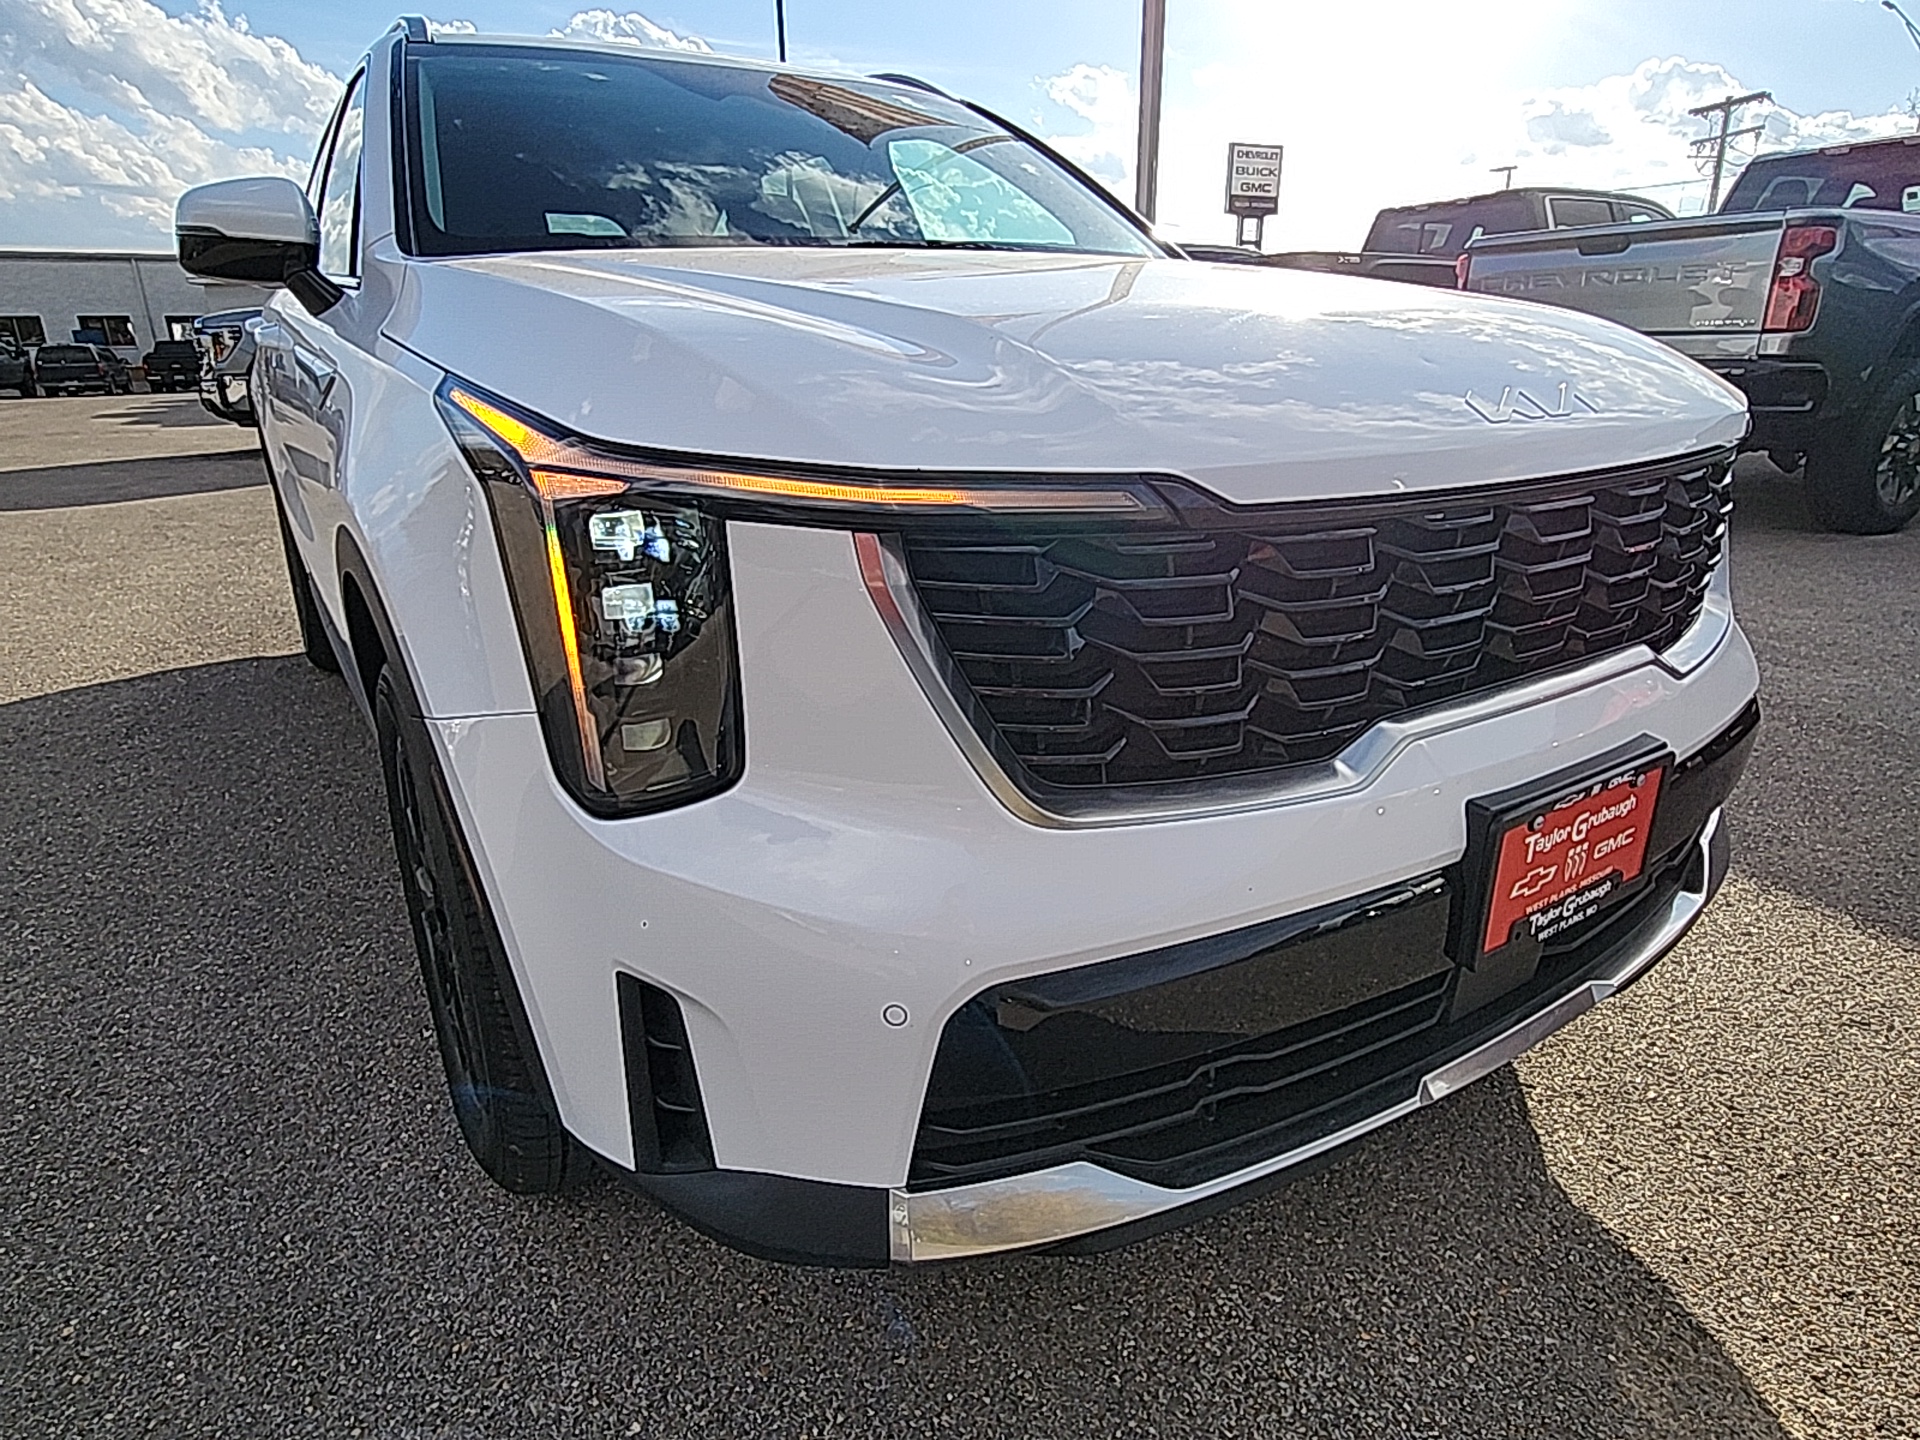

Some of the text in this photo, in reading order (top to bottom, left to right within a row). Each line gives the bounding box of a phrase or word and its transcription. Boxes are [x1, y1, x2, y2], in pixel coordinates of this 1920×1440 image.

[1236, 149, 1279, 160] CHEVROLET
[1235, 166, 1278, 177] BUICK
[1240, 182, 1272, 193] GMC
[1525, 793, 1637, 863] Taylor Grubaugh
[1593, 827, 1636, 860] GMC
[1525, 897, 1549, 915] WEST
[1529, 880, 1612, 936] Taylor Grubaugh
[1538, 923, 1558, 942] WEST
